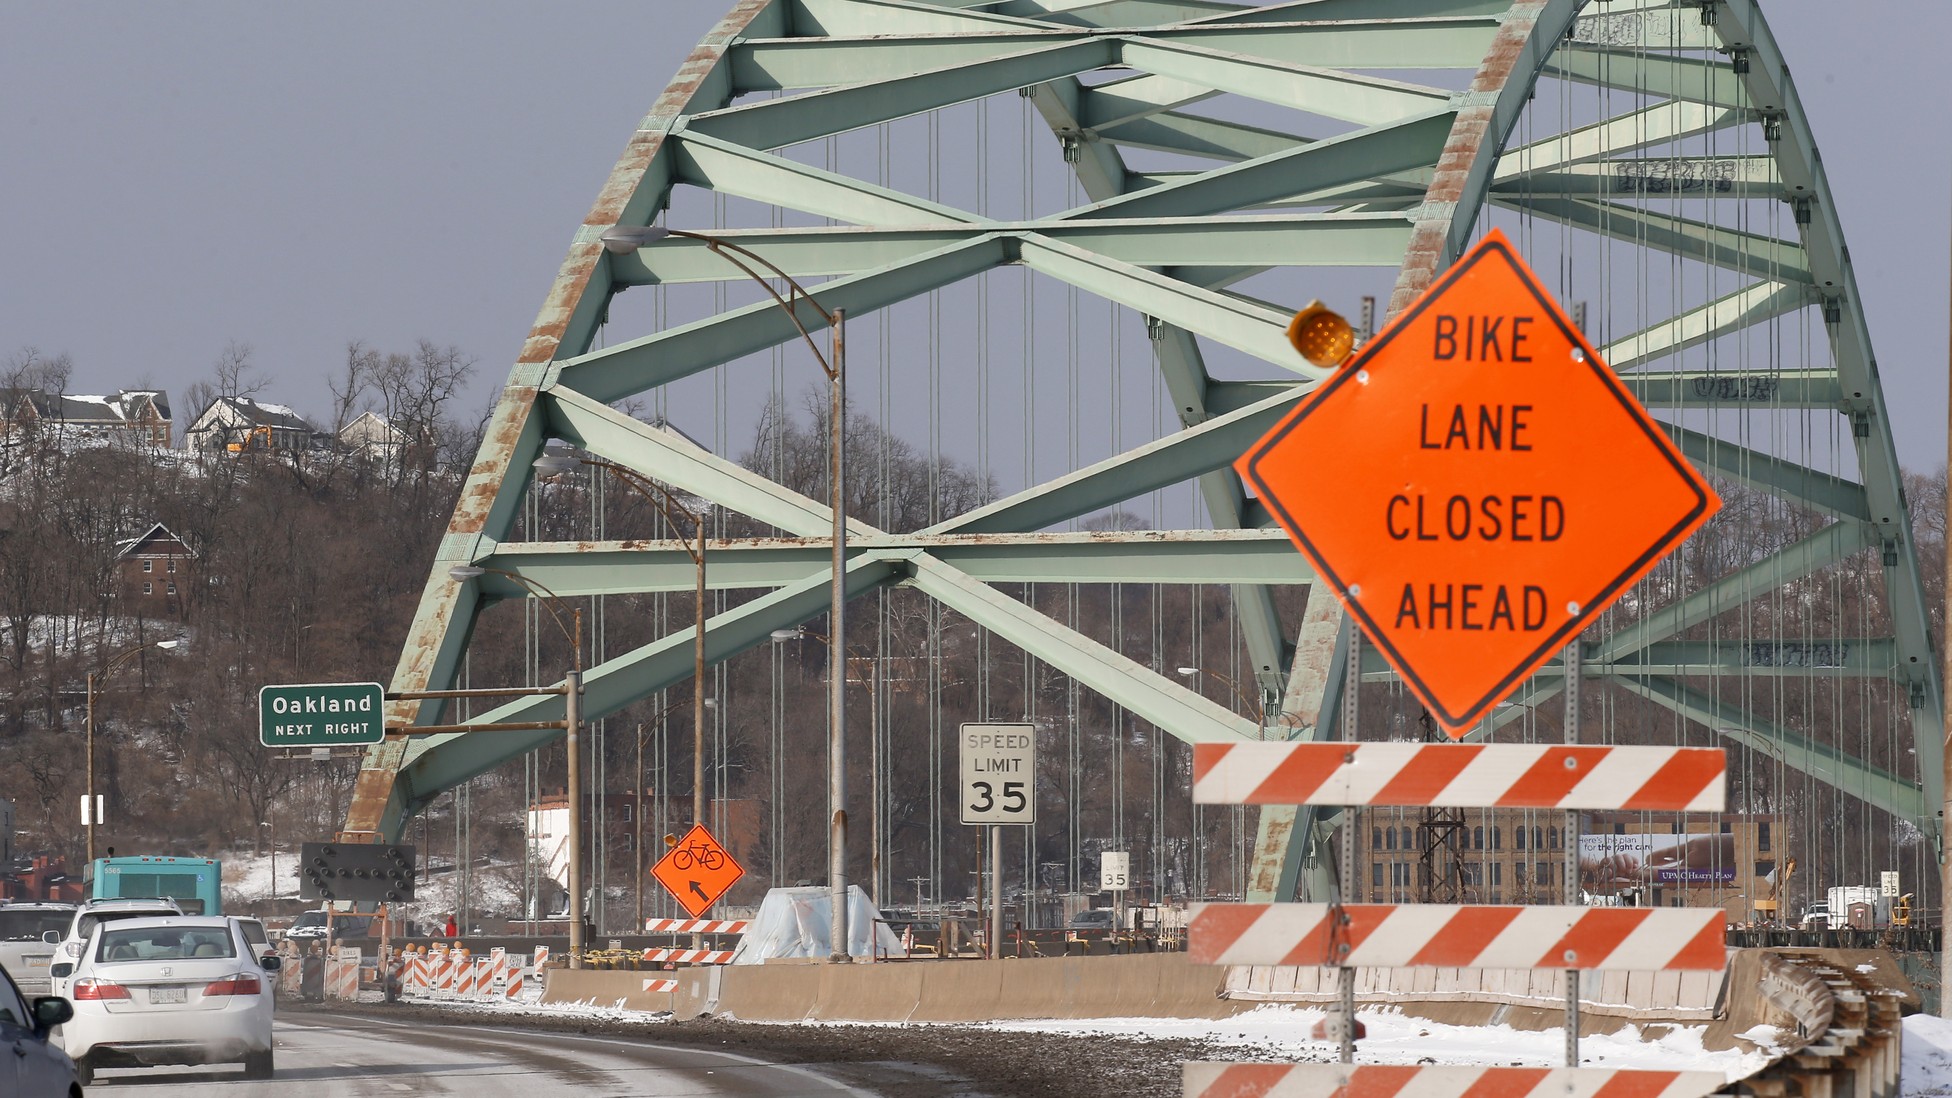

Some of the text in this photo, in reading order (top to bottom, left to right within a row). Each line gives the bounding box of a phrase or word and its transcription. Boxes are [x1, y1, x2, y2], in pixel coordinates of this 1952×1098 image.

[1434, 315, 1534, 362] BIKE
[1420, 403, 1533, 451] LANE
[1387, 494, 1565, 542] CLOSED
[1395, 584, 1548, 631] AHEAD
[272, 694, 371, 714] Oakland
[275, 723, 369, 736] NEXT RIGHT
[968, 734, 1030, 749] SPEED
[974, 758, 1022, 772] LIMIT
[970, 781, 1026, 813] 35
[1584, 843, 1597, 851] for
[1597, 843, 1612, 851] the
[1619, 836, 1637, 846] plan
[1104, 873, 1126, 886] 35
[1884, 885, 1897, 894] 35
